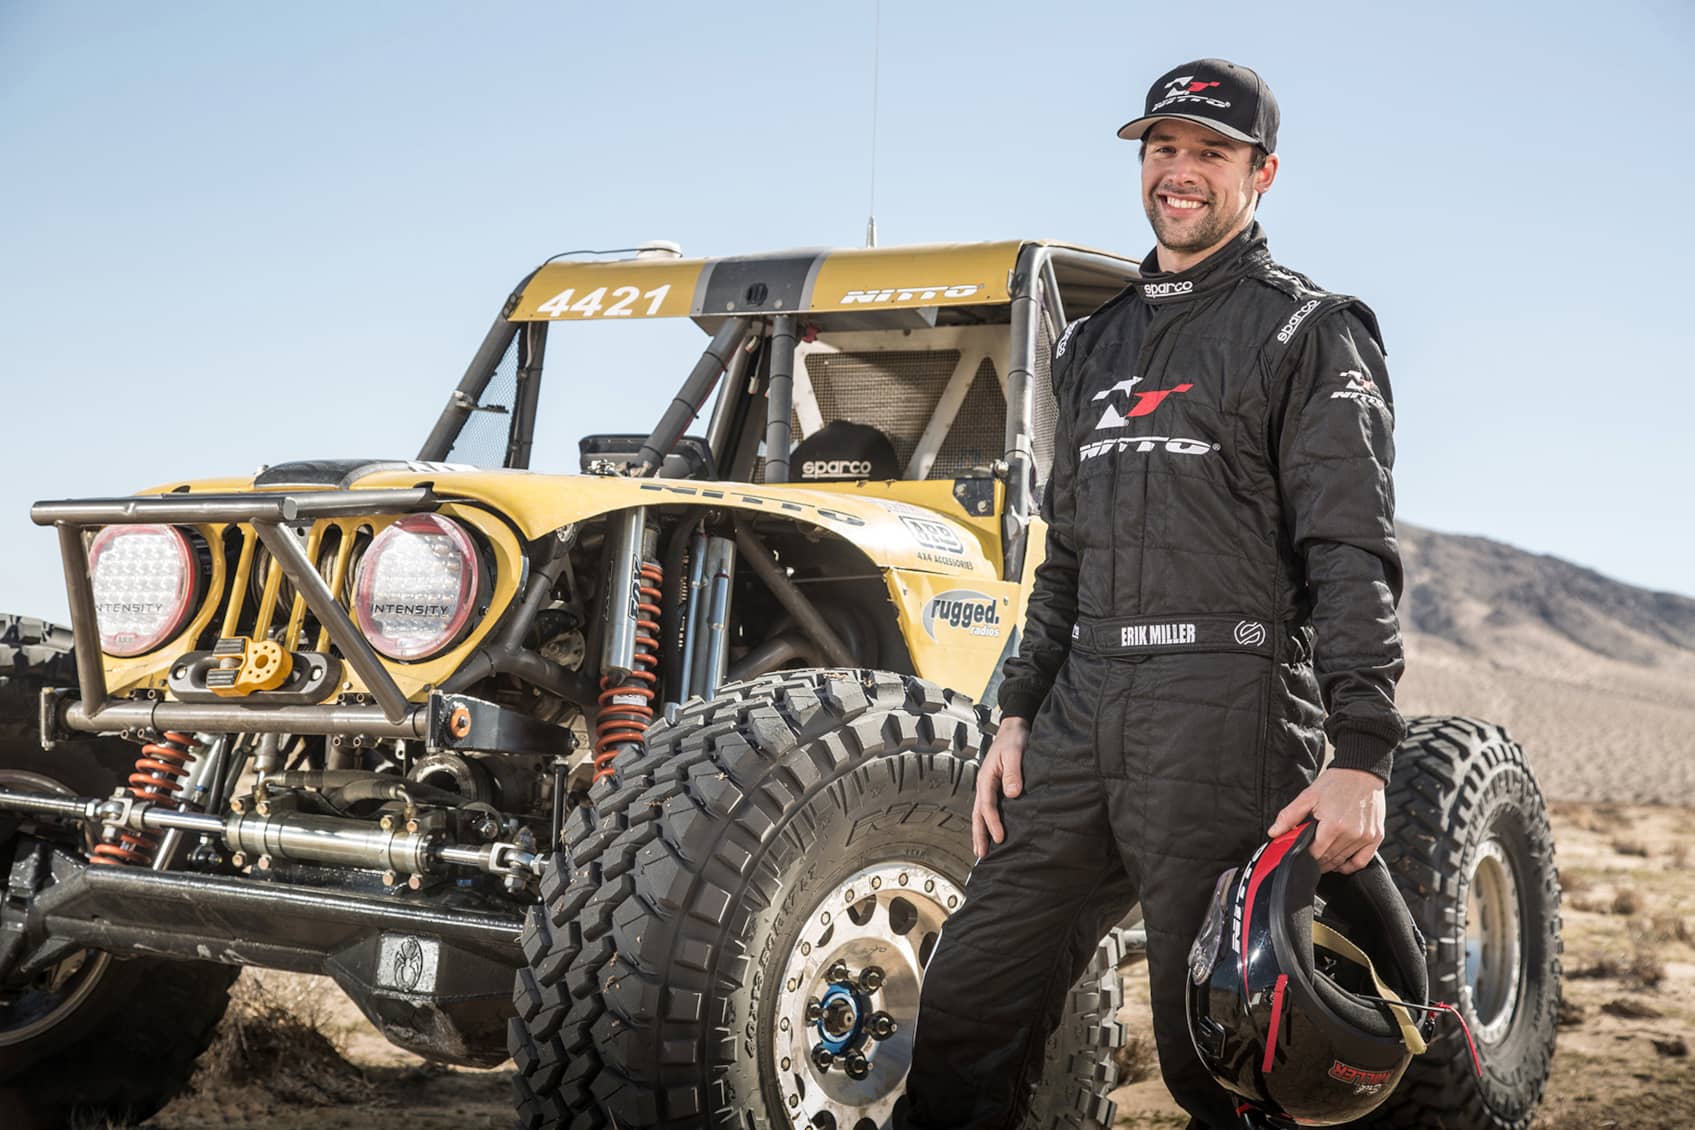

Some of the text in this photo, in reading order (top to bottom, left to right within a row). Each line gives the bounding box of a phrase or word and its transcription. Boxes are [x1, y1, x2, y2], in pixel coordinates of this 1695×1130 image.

[840, 285, 977, 304] NITTO
[1144, 281, 1193, 298] sparco
[537, 284, 671, 317] 4421
[1277, 300, 1320, 344] sparco
[802, 461, 872, 479] sparco
[96, 603, 163, 614] NTENSITY
[370, 603, 449, 616] INTENSITY
[970, 625, 1000, 638] radios
[1121, 623, 1196, 647] ERIK MILLER
